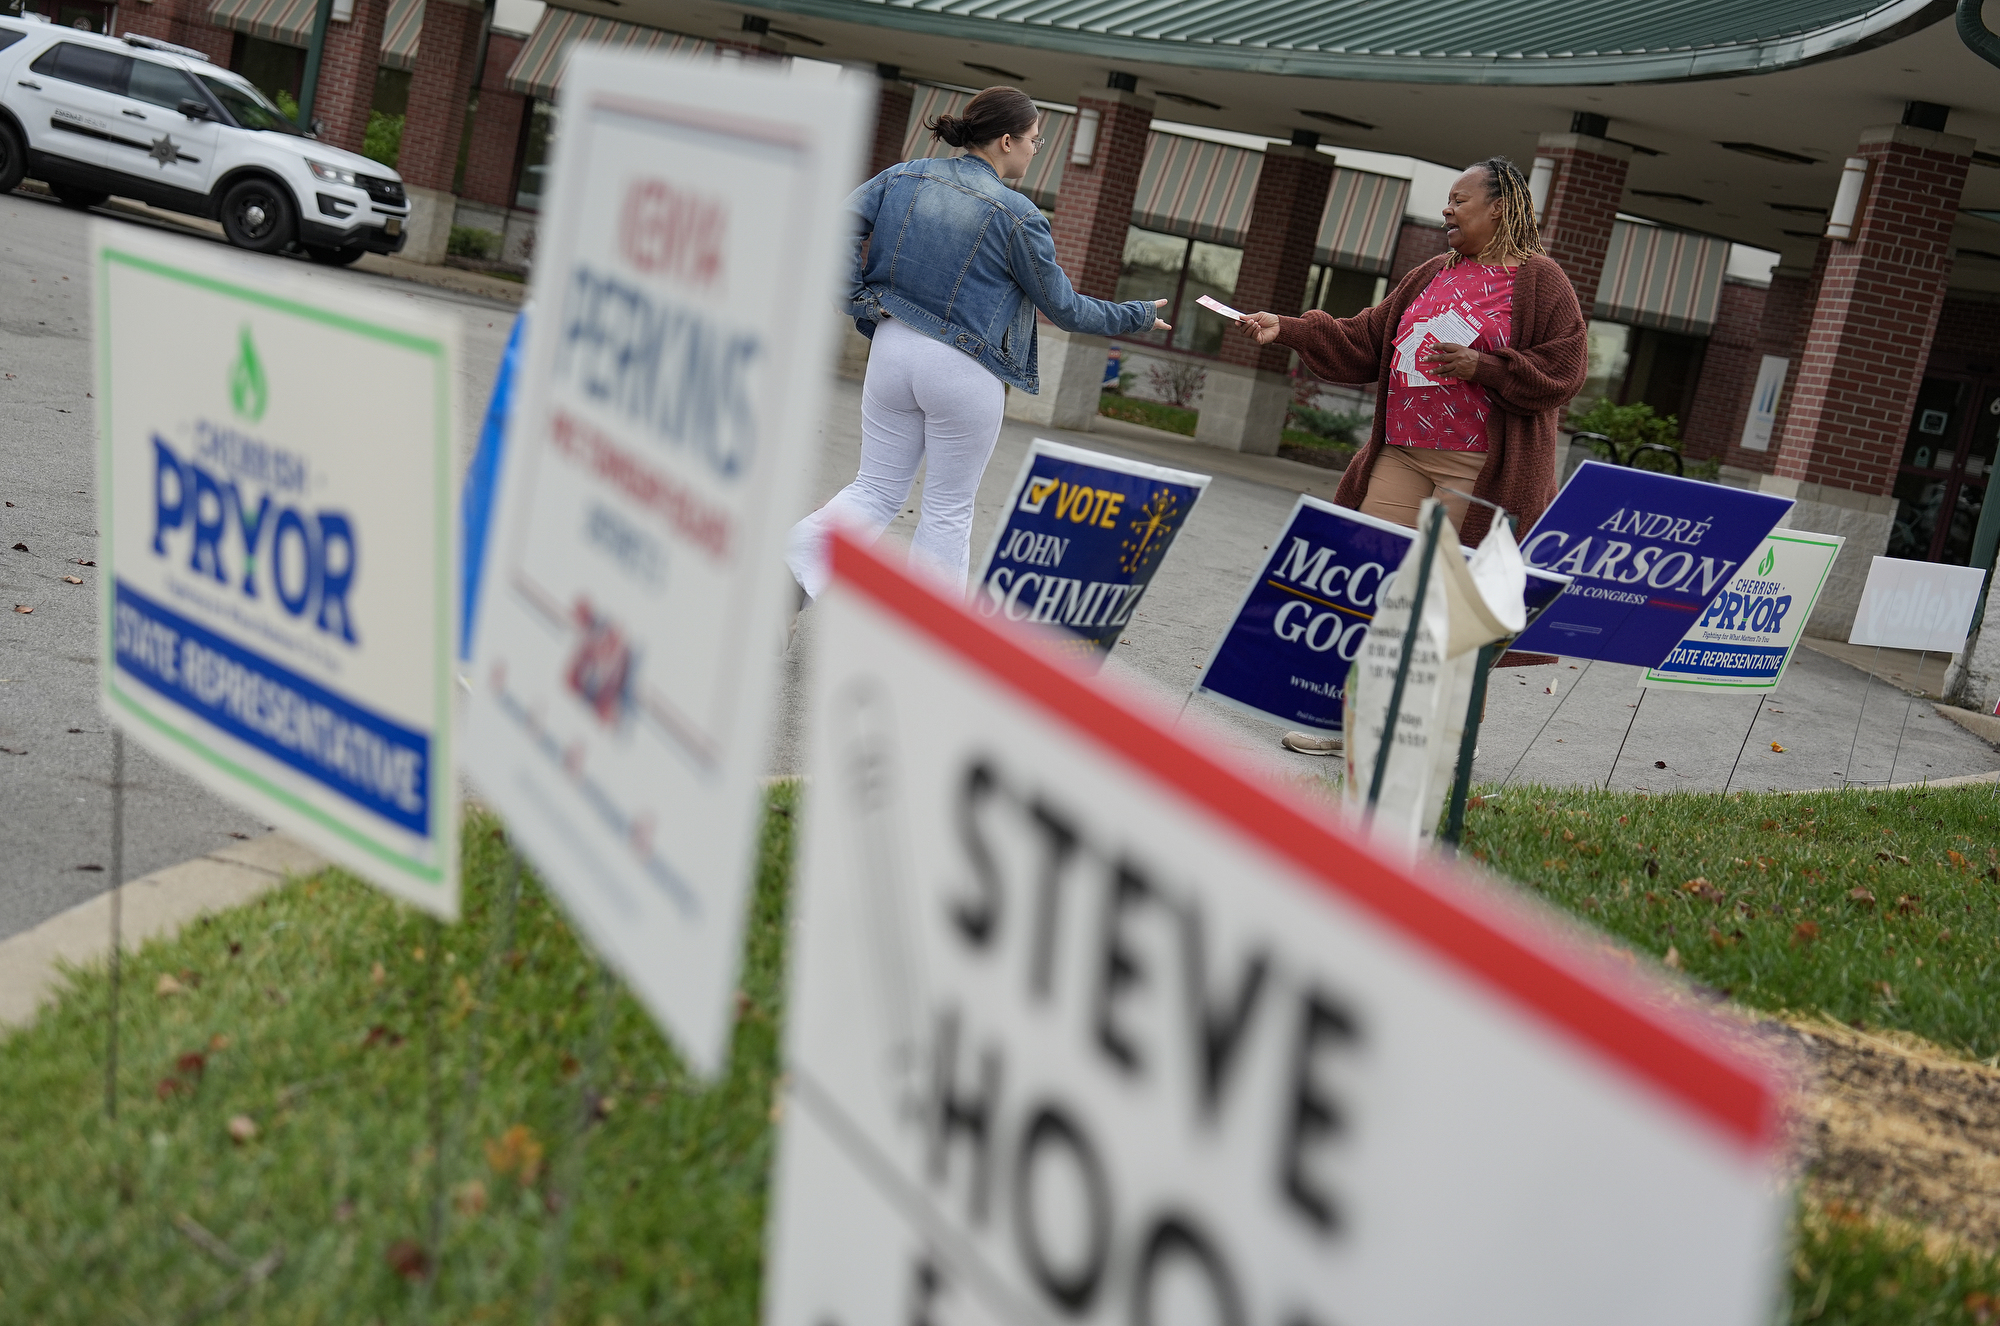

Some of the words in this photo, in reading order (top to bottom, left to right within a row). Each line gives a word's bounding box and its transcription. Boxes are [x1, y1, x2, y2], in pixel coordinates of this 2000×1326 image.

[1055, 481, 1126, 529] VOTE
[1597, 507, 1715, 546] ANDRÉ
[152, 431, 358, 645] PRYOR
[999, 527, 1071, 568] JOHN
[1520, 530, 1737, 596] CARSON
[1735, 578, 1781, 596] CHERRISH
[978, 566, 1145, 627] SCHMITZ
[1564, 579, 1583, 596] OR
[1583, 585, 1648, 605] CONGRESS
[1699, 589, 1792, 634] PRYOR
[1699, 650, 1784, 670] REPRESENTATIVE
[179, 637, 423, 815] REPRESENTATIVE
[950, 762, 1366, 1234] STEVE
[926, 1008, 1250, 1326] HOO
